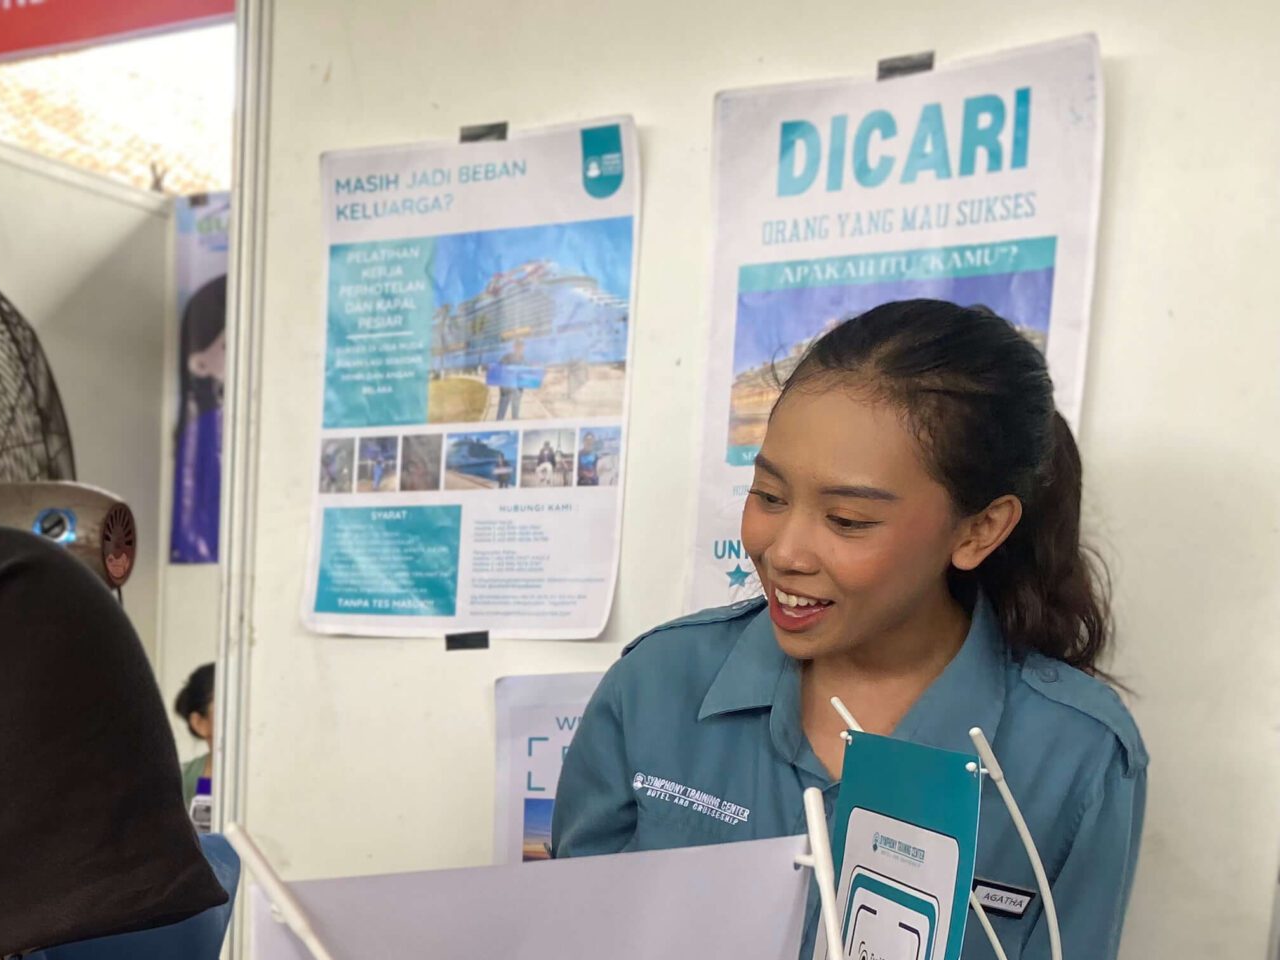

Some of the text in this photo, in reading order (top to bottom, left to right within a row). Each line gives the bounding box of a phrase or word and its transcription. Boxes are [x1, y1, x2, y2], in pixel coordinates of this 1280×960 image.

[777, 86, 1031, 197] DICARI
[335, 159, 527, 195] MASIH JADI BEBAN
[336, 193, 454, 222] KELUARGA?
[762, 191, 1037, 245] ORANG YANG MAU SUKSES
[346, 246, 420, 263] PELATIHAN
[779, 256, 874, 284] APAKAH
[877, 254, 916, 277] ITU
[339, 280, 425, 298] PERHOTELAN
[345, 301, 373, 314] DAN
[358, 315, 403, 329] PESIAR
[371, 510, 408, 520] SYARAT
[499, 503, 572, 512] HUBUNGI KAMI
[337, 598, 369, 608] TANPA
[372, 599, 390, 609] TES
[645, 775, 750, 819] SYMPHONY TRAINING CENTER
[673, 796, 690, 808] AND
[692, 803, 739, 826] CRUISESHIP
[983, 892, 1023, 908] AGATHA
